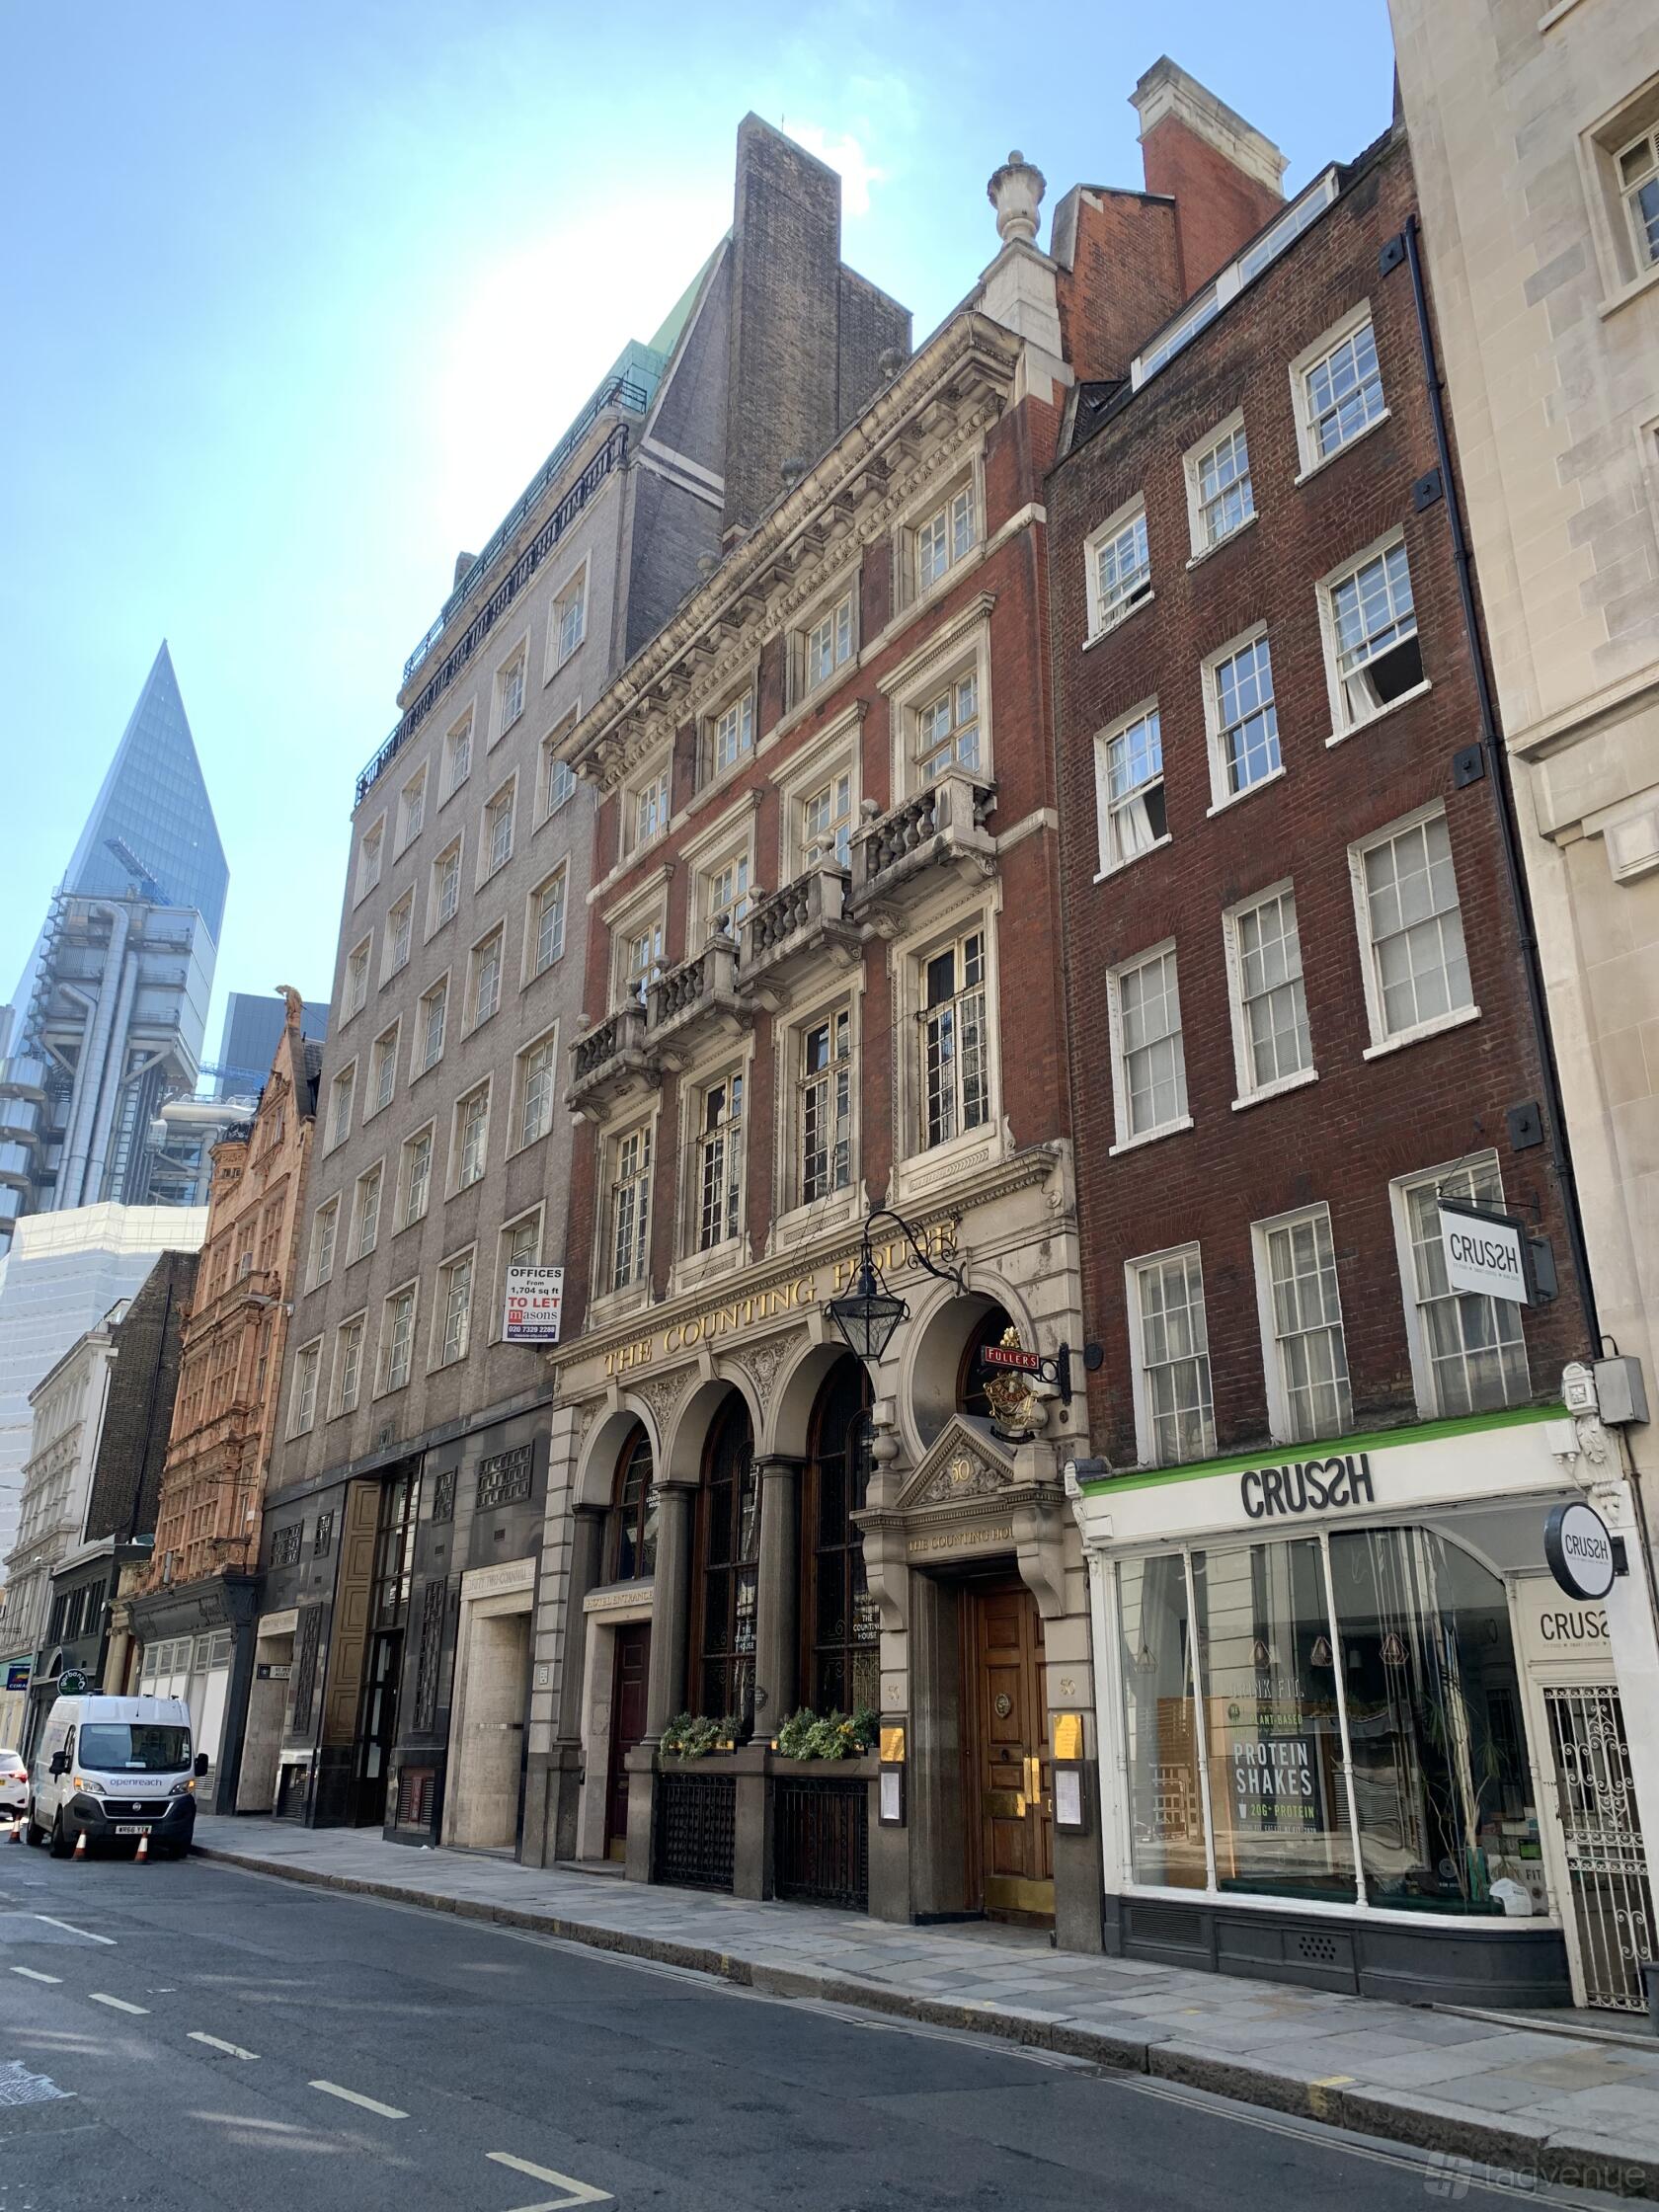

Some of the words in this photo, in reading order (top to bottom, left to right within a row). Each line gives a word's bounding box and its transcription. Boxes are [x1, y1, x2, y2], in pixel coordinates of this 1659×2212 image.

[1450, 1233, 1519, 1274] CRUSSH
[511, 1268, 562, 1278] OFFICES
[508, 1297, 528, 1308] TO
[532, 1297, 561, 1308] LET
[509, 1310, 558, 1320] masons
[604, 1338, 652, 1378] THE
[664, 1275, 817, 1354] COUNTING
[952, 1460, 970, 1482] 50
[1240, 1454, 1375, 1519] CRUSSH
[908, 1539, 928, 1553] THE
[931, 1530, 989, 1549] COUNTING
[991, 1527, 1014, 1540] HOU
[1565, 1534, 1609, 1560] CRUSSH
[586, 1596, 612, 1609] HOTEL
[862, 1614, 873, 1622] THE
[1540, 1610, 1611, 1641] CRUSS
[853, 1623, 880, 1632] COUNTIN
[857, 1631, 878, 1640] HOUSE
[888, 1686, 900, 1701] 50
[1060, 1679, 1076, 1696] 50
[1234, 1742, 1308, 1766] PROTEIN
[110, 1778, 163, 1786] openreach
[1236, 1769, 1312, 1795] SHAKES
[1274, 1805, 1315, 1819] PROTEIN
